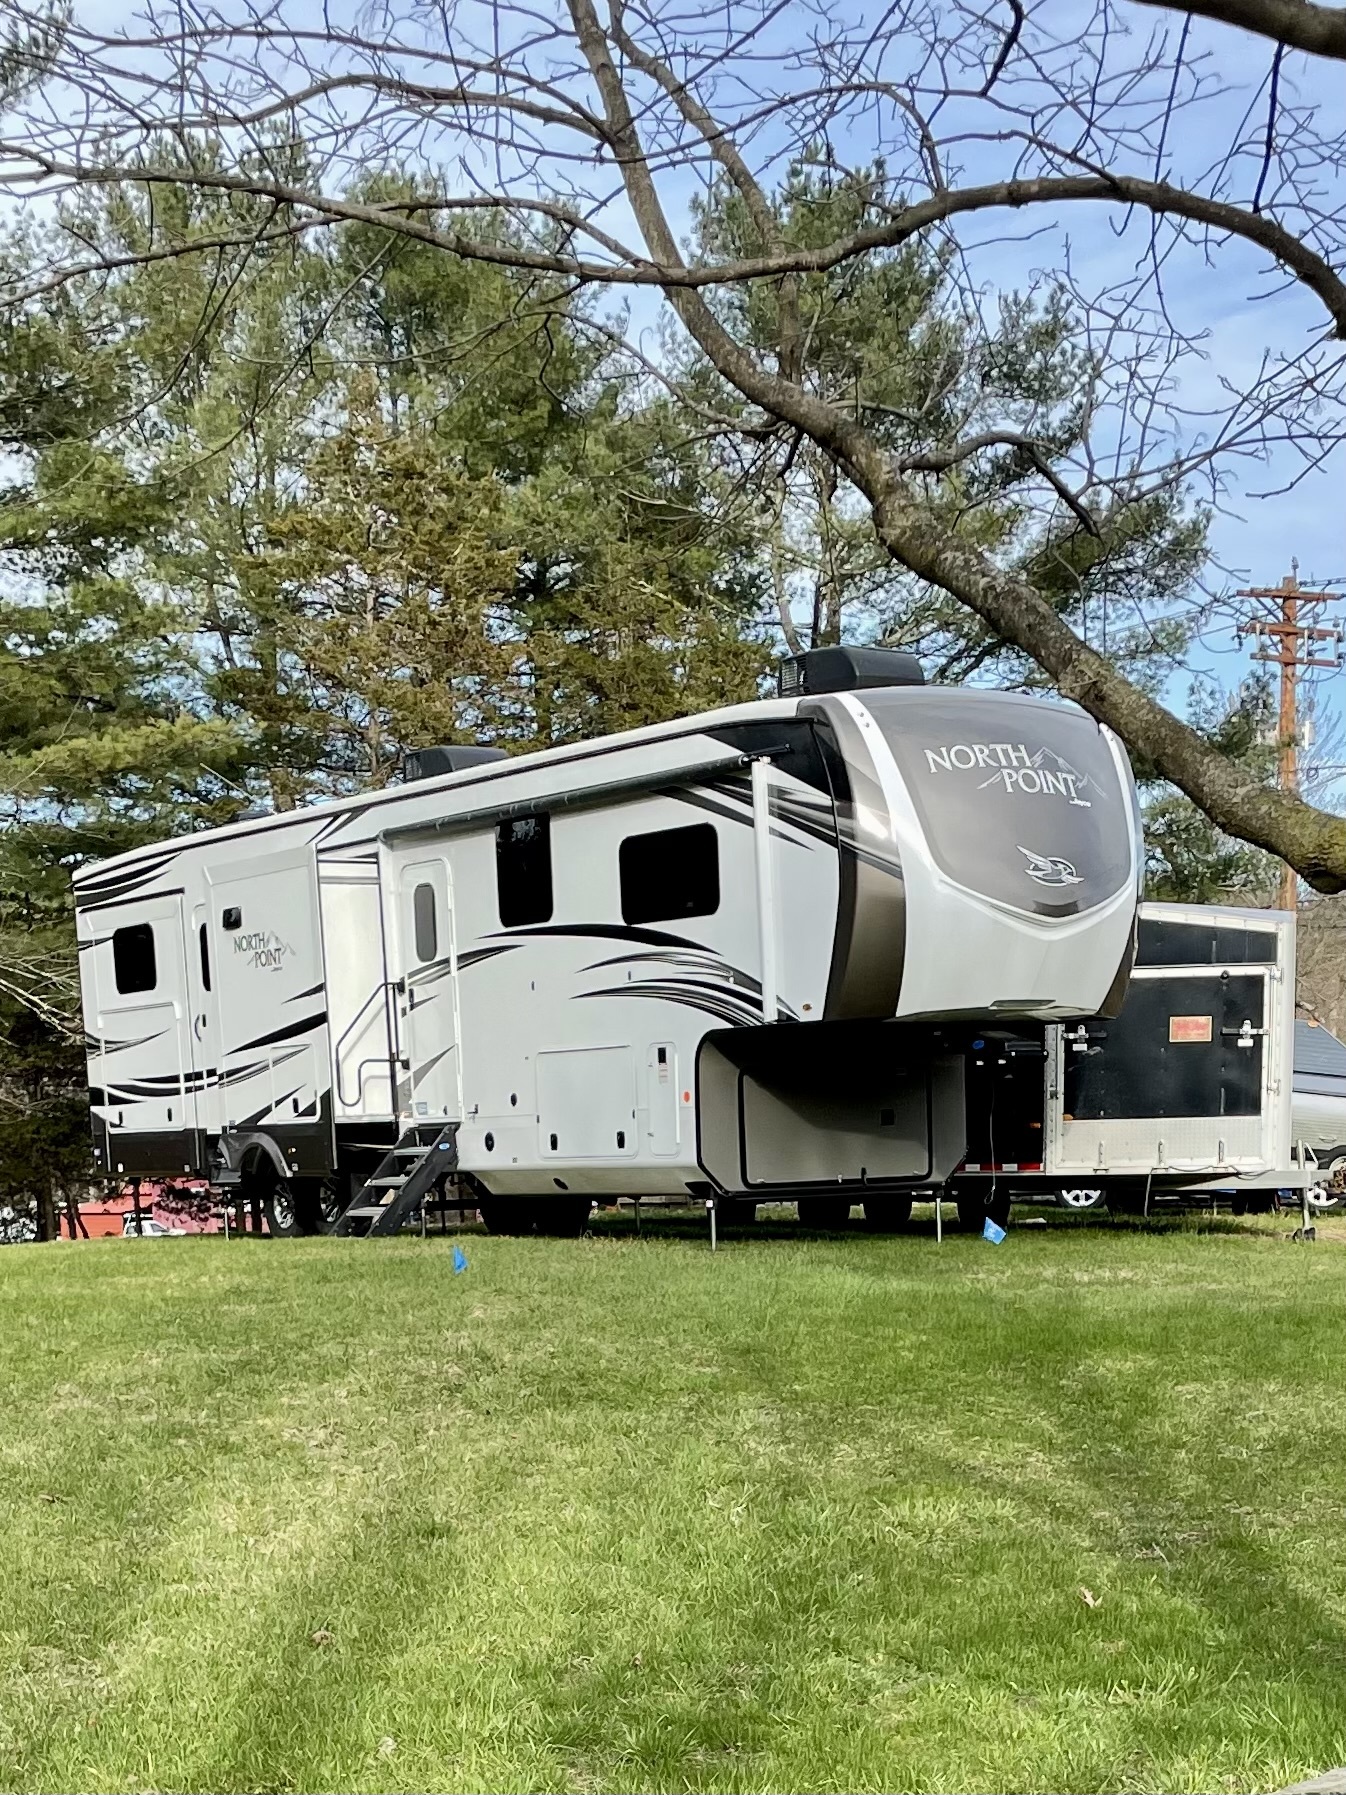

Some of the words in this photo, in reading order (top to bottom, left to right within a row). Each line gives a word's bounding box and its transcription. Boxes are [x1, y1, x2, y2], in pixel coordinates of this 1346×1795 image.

[924, 743, 1032, 773] NORTH
[1001, 768, 1077, 797] POINT
[233, 931, 267, 954] NORTH
[254, 948, 281, 968] POINT
